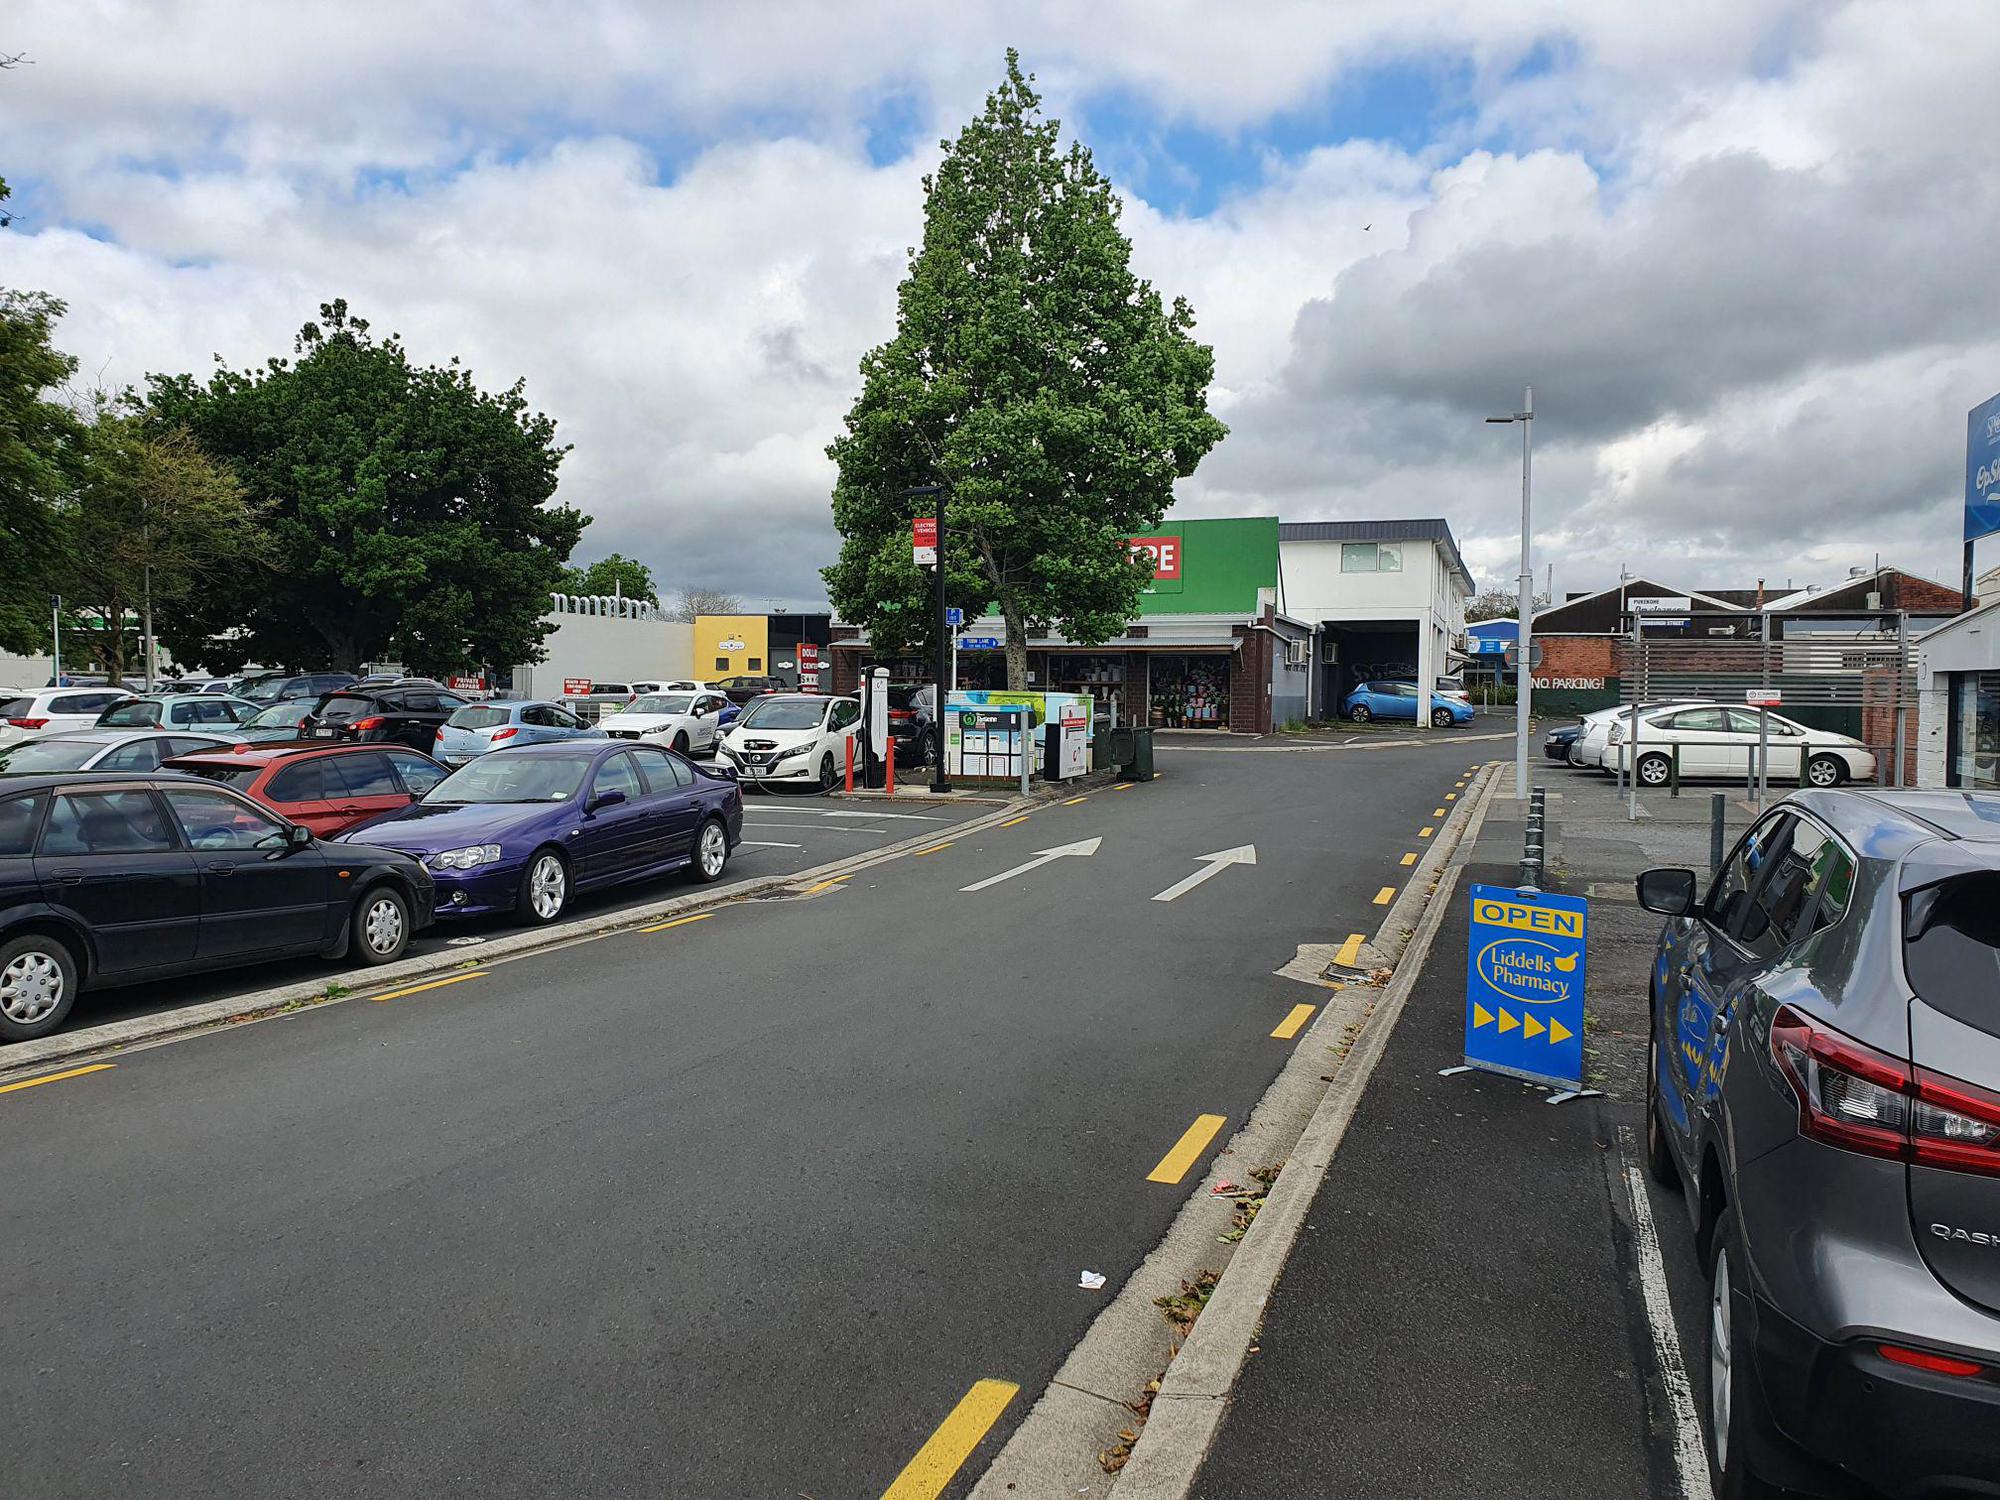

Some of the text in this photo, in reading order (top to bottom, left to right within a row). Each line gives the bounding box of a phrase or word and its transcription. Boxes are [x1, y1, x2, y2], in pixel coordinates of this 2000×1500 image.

[1531, 677, 1605, 690] NO PARKING!
[1481, 904, 1576, 933] OPEN
[1491, 947, 1552, 973] Liddells
[1493, 965, 1569, 998] Pharmacy
